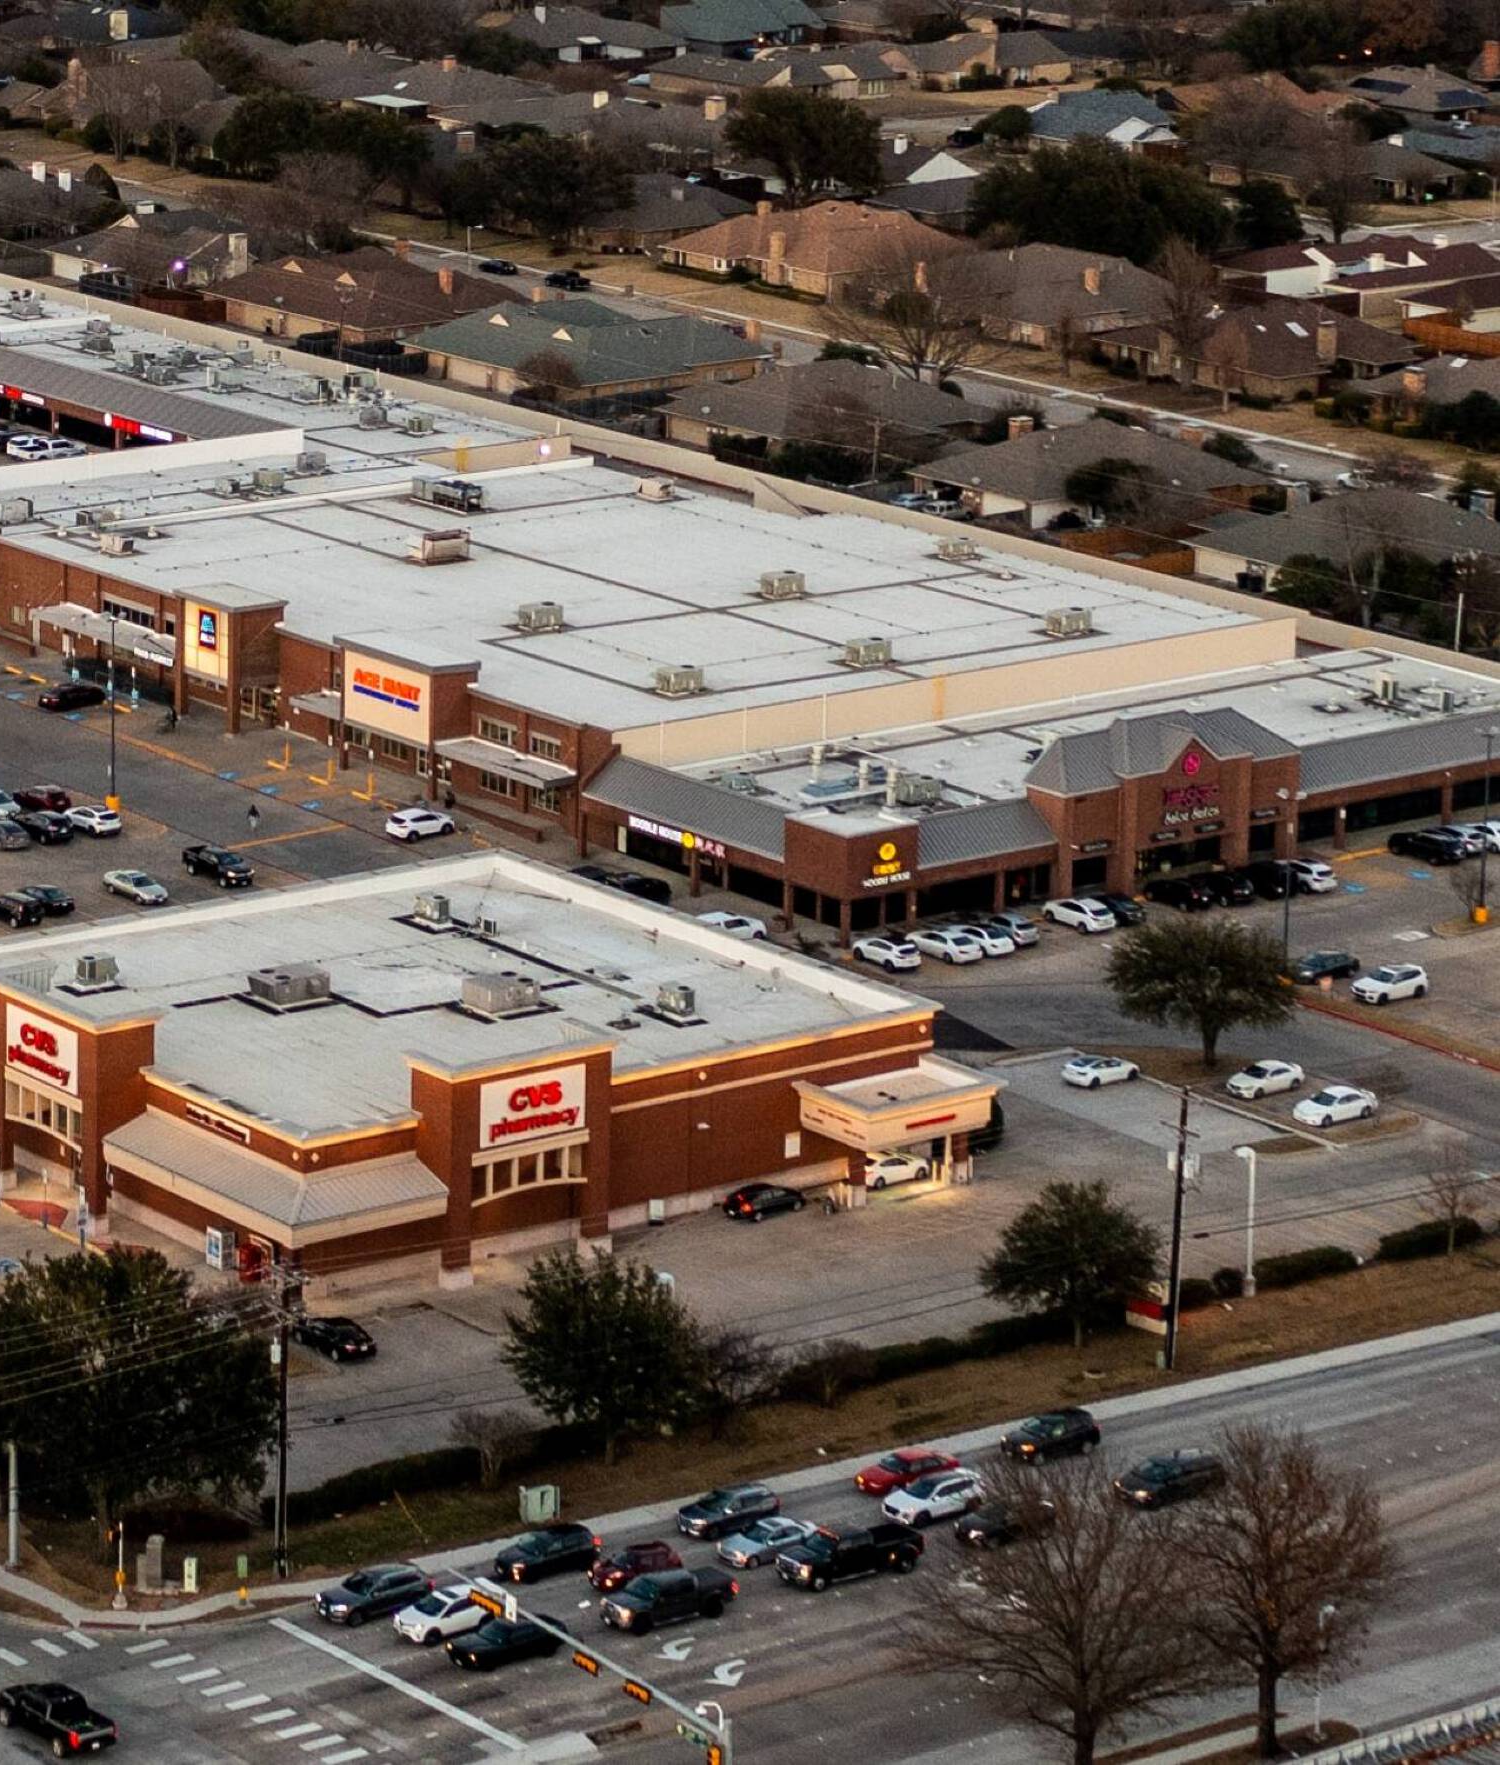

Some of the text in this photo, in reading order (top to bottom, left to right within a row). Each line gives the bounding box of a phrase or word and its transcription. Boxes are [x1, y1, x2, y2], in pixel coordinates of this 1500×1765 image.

[354, 669, 421, 702] ACE MART
[20, 1023, 58, 1058] CVS
[8, 1044, 71, 1087] pharmacy
[508, 1080, 563, 1113] CVS
[489, 1105, 580, 1144] pharmacy
